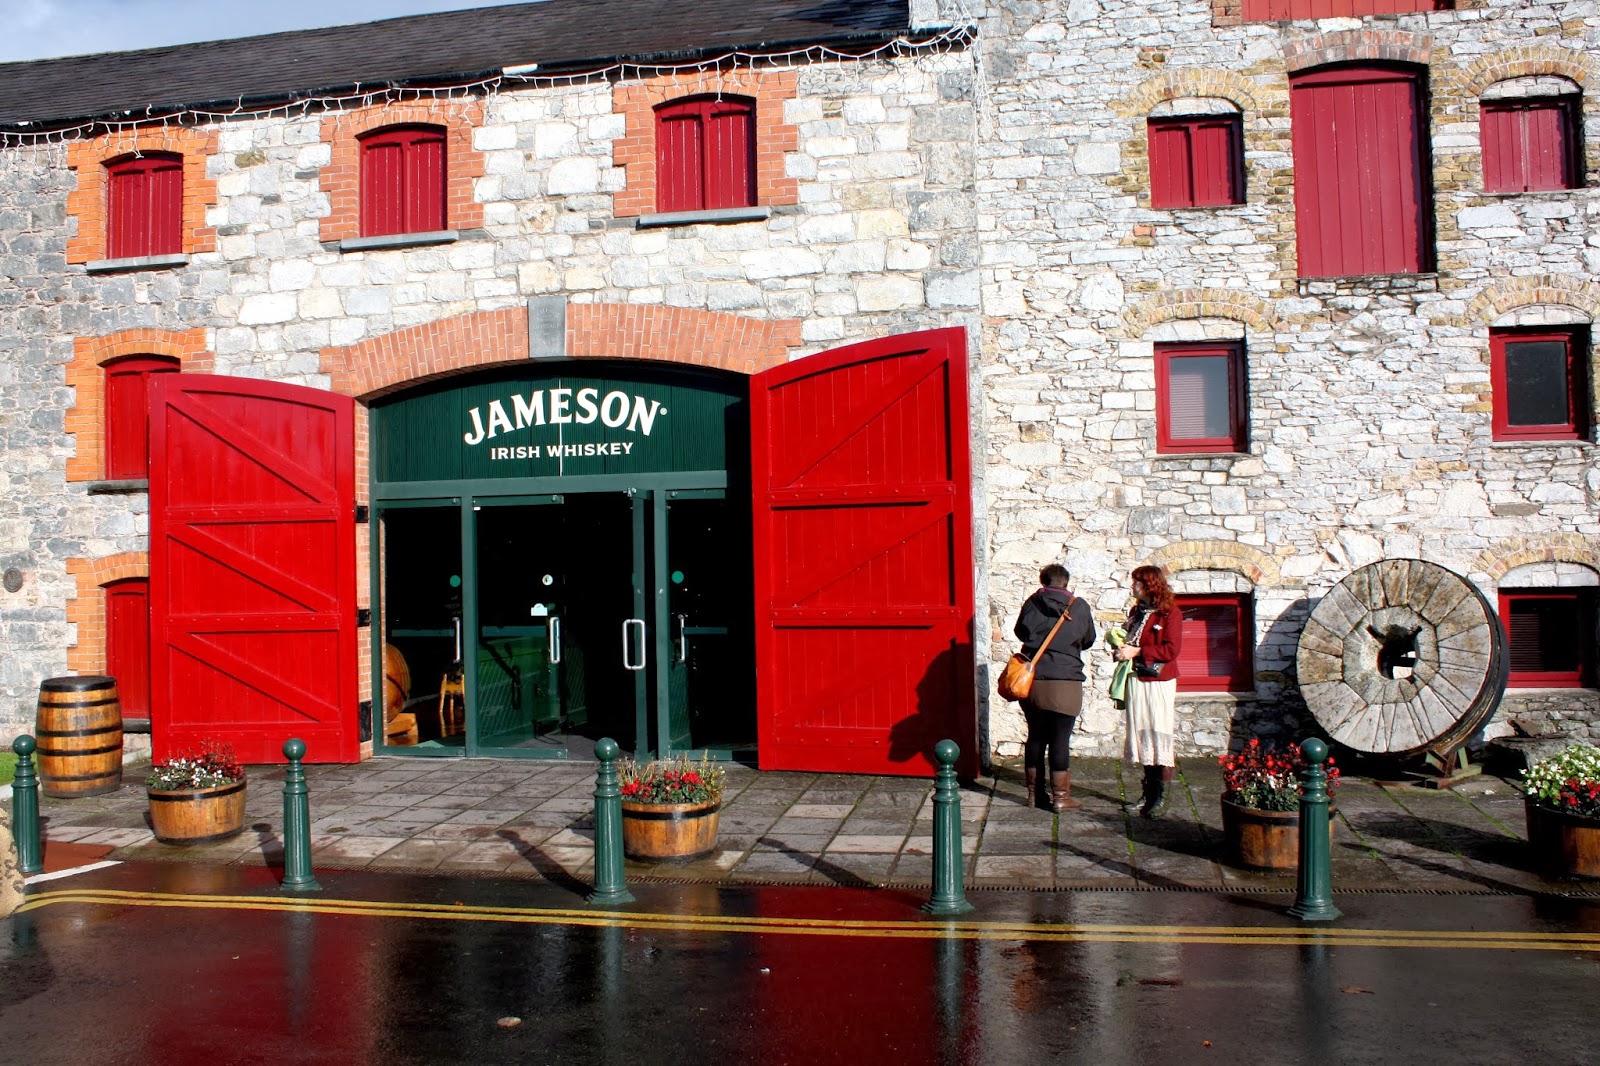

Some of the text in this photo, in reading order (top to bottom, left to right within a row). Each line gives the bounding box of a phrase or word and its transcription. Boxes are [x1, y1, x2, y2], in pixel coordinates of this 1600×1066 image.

[463, 387, 661, 446] JAMESON
[490, 442, 634, 460] IRISH WHISKEY
